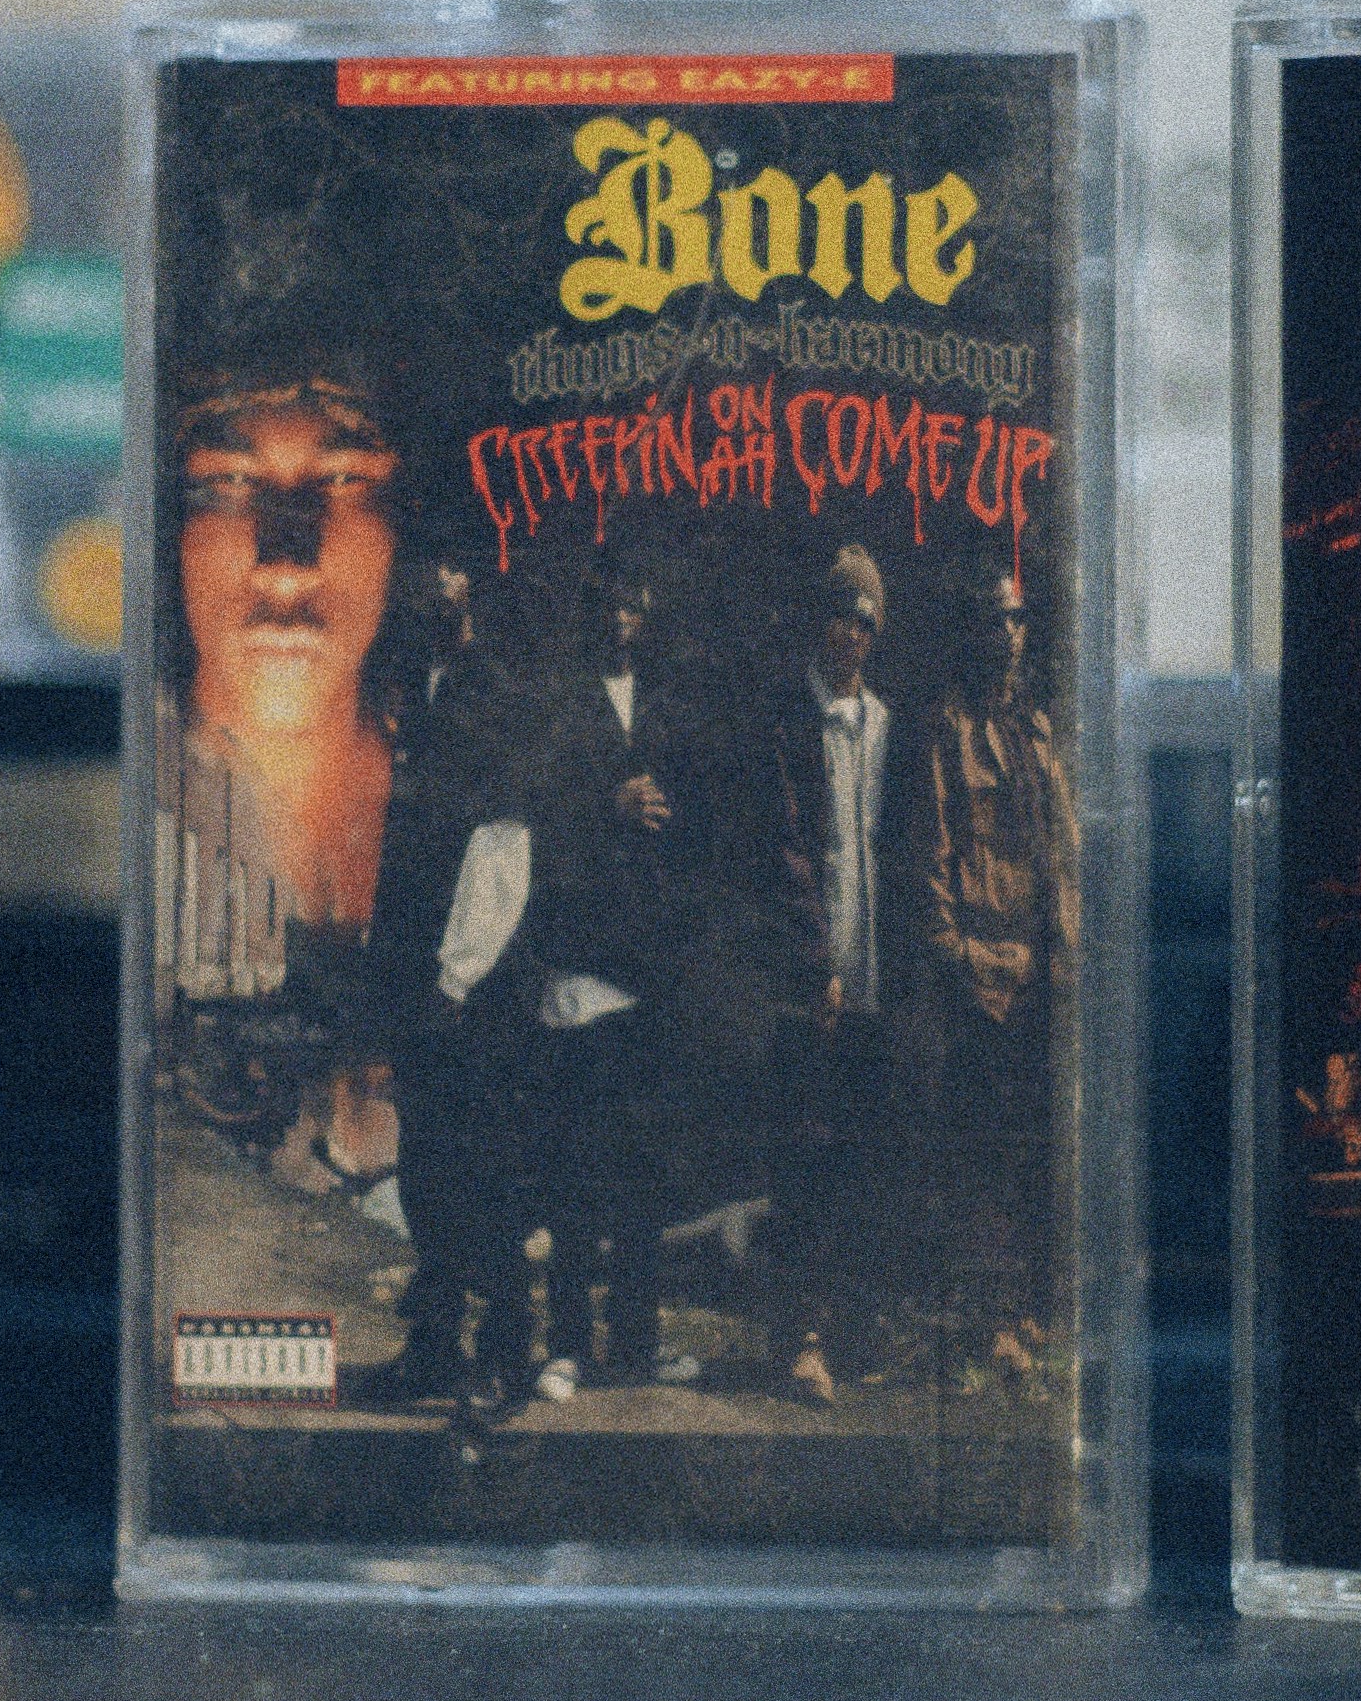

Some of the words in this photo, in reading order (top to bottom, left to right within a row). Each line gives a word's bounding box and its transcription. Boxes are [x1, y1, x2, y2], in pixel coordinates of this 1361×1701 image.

[359, 66, 658, 95] FEATURING
[679, 66, 873, 93] EAZY-E
[559, 115, 981, 322] Bone
[785, 391, 961, 545] COME
[967, 421, 1053, 603] UP
